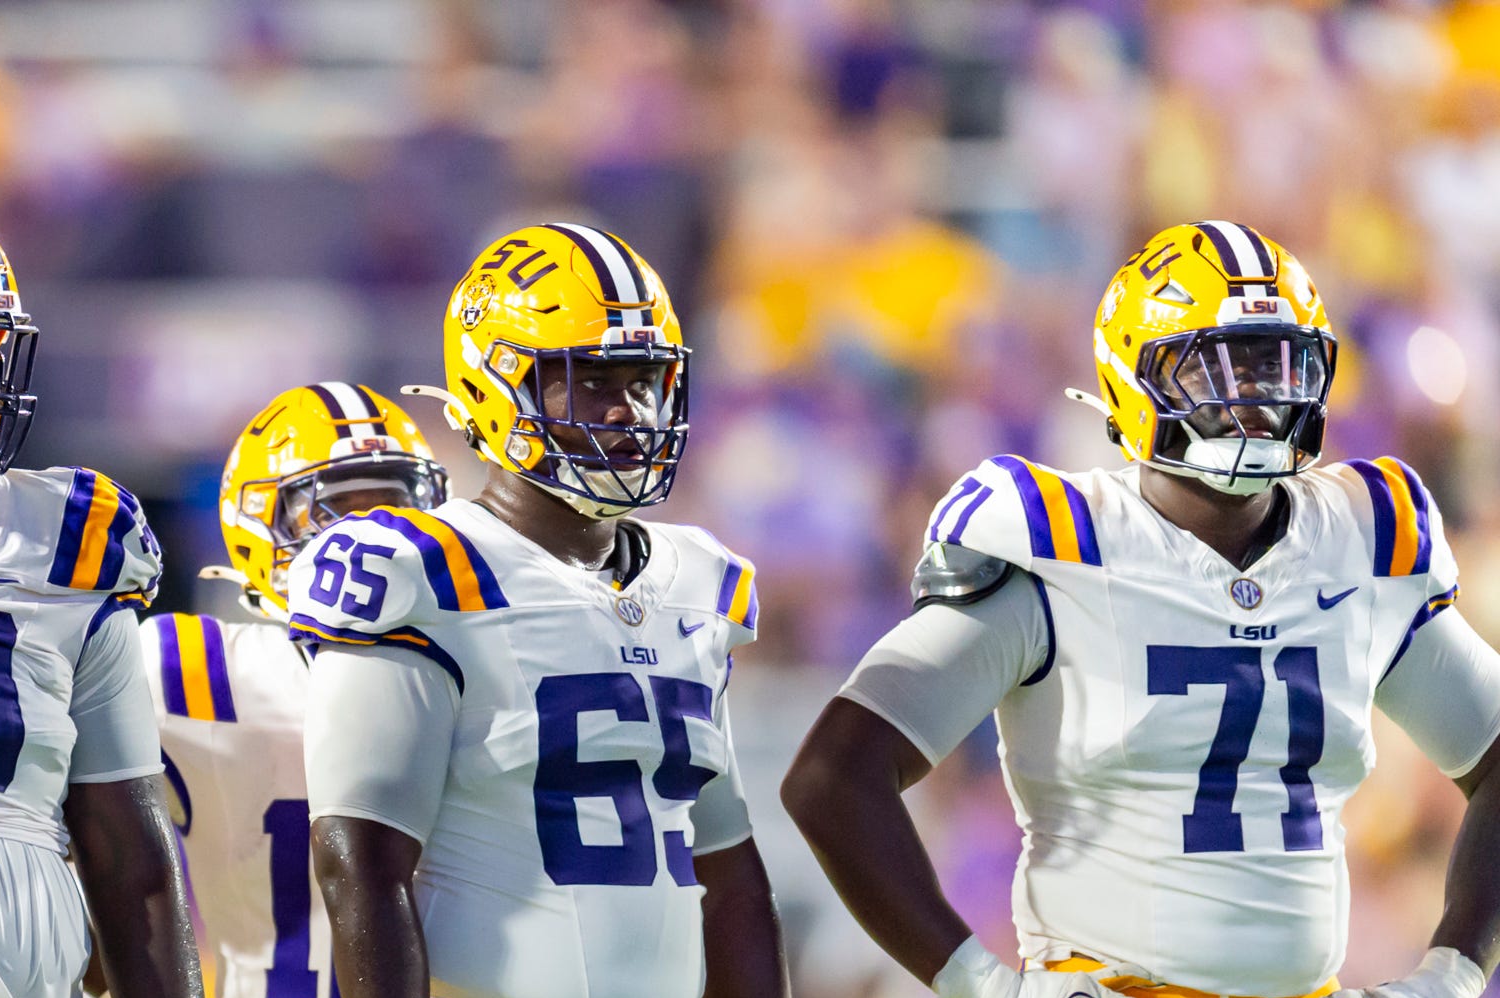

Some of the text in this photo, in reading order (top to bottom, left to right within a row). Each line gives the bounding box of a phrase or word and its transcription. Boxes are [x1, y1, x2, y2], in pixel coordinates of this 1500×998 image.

[1240, 300, 1278, 314] LSU
[621, 330, 656, 344] LSU
[350, 438, 388, 452] LSU
[308, 533, 397, 622] 65
[1232, 579, 1261, 608] SEC
[618, 598, 643, 625] SEC
[1229, 624, 1277, 640] LSU
[620, 646, 659, 665] LSU
[1146, 645, 1325, 854] 71
